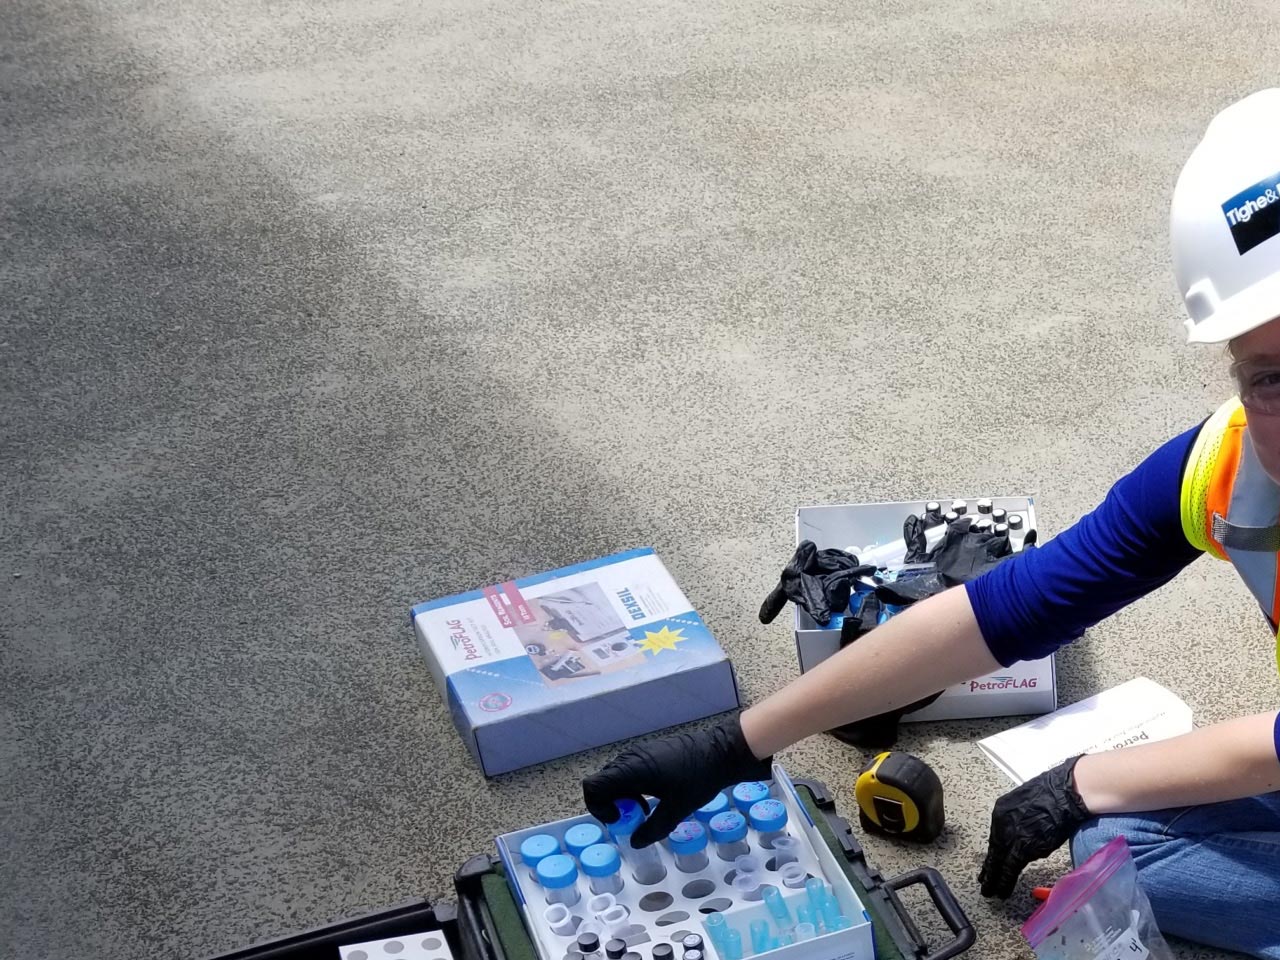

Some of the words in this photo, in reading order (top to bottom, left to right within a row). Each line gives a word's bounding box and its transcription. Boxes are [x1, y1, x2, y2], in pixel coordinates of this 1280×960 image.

[616, 587, 647, 621] DEXSIL
[446, 619, 483, 661] PetroFLAG
[969, 677, 1038, 693] PetroFLAG
